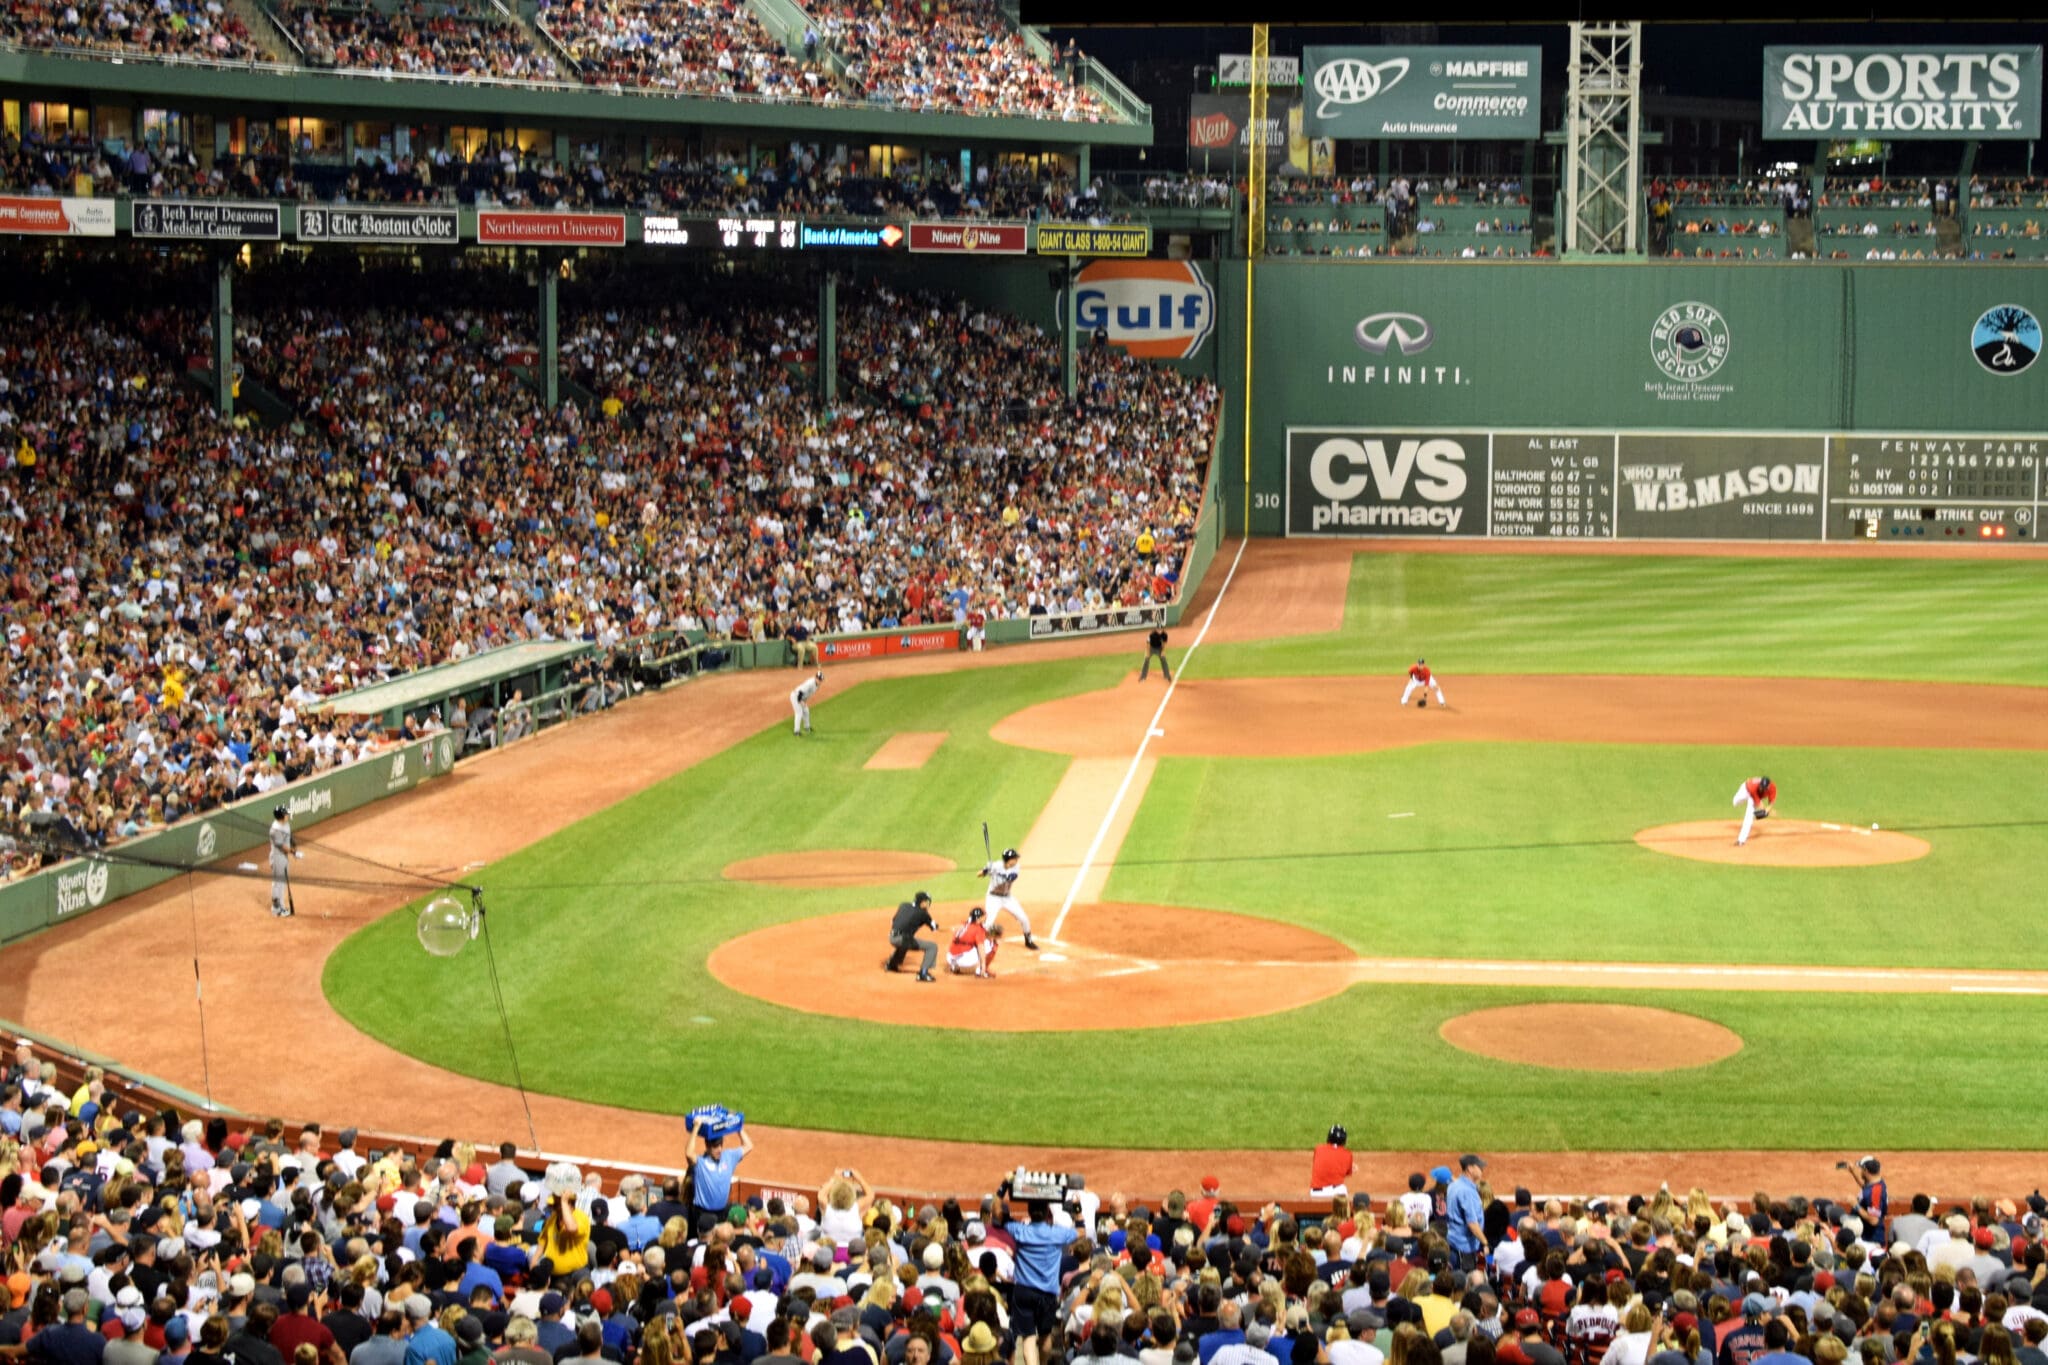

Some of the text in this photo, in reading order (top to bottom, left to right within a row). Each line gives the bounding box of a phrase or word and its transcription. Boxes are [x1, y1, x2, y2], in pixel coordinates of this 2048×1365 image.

[1446, 61, 1528, 77] MAPFRE
[1782, 53, 2020, 101] SPORTS
[1323, 61, 1373, 103] AAA
[1434, 92, 1528, 110] Commerce
[1782, 102, 2019, 131] AUTHORITY
[1195, 117, 1229, 146] New
[1382, 121, 1457, 133] Auto Insurance
[162, 204, 274, 224] Beth Israel Deaconess
[162, 220, 242, 236] Medical Center
[332, 213, 451, 237] The Boston Globe
[485, 219, 619, 240] Northeastern University
[804, 227, 878, 246] Bank of America
[931, 229, 1001, 246] Ninety Nine
[1040, 231, 1063, 249] GIANT
[1065, 231, 1090, 250] GLASS
[1122, 233, 1145, 251] GIANT
[1076, 289, 1202, 330] Gulf
[1655, 304, 1717, 341] RED SOX
[1657, 334, 1727, 378] SCHOLARS
[1328, 366, 1461, 385] INFINITI
[1645, 381, 1734, 392] Beth Israel Deaconess
[1657, 391, 1721, 401] Medical Center
[1528, 438, 1579, 449] AL EAST
[1881, 440, 2038, 454] FENWAY PARK
[1551, 456, 1599, 468] W L GB
[1851, 453, 1859, 466] P
[1920, 454, 1928, 467] 2
[1932, 454, 1940, 467] 3
[1946, 455, 1955, 467] 4
[1958, 455, 1966, 467] 5
[1969, 455, 1977, 468] 6
[1985, 455, 1992, 468] 7
[1996, 455, 2004, 468] 8
[2007, 455, 2015, 468] 9
[2021, 455, 2033, 468] 10
[1310, 438, 1468, 501] CVS
[1494, 470, 1580, 482] BALTIMORE 60 47
[1622, 463, 1683, 481] WHO BUT
[1876, 468, 1892, 480] NY
[1908, 468, 1916, 480] 0
[1920, 468, 1927, 480] 0
[1931, 468, 1938, 481] 0
[1494, 484, 1541, 496] TORONTO
[1550, 483, 1564, 496] 60
[1567, 483, 1580, 496] 50
[1632, 464, 1822, 512] W.B.MASON
[1863, 483, 1904, 495] BOSTON
[1908, 483, 1916, 496] 0
[1920, 483, 1927, 496] 0
[1255, 493, 1280, 508] 310
[1494, 497, 1515, 509] NEW
[1518, 497, 1543, 509] YORK
[1566, 497, 1580, 510] 52
[1312, 501, 1463, 533] pharmacy
[1743, 503, 1815, 515] SINCE 1898
[1848, 507, 1883, 520] AT BAT
[1893, 508, 1922, 521] BALL
[1935, 508, 1974, 521] STRIKE
[1979, 509, 2005, 521] OUT
[1493, 511, 1524, 522] TAMPA
[1526, 511, 1544, 523] BAY
[1586, 511, 1592, 524] 7
[1493, 524, 1534, 536] BOSTON
[1566, 524, 1579, 537] 60
[1584, 524, 1594, 537] 12
[288, 788, 332, 819] Poland Spring
[57, 889, 87, 915] Nine
